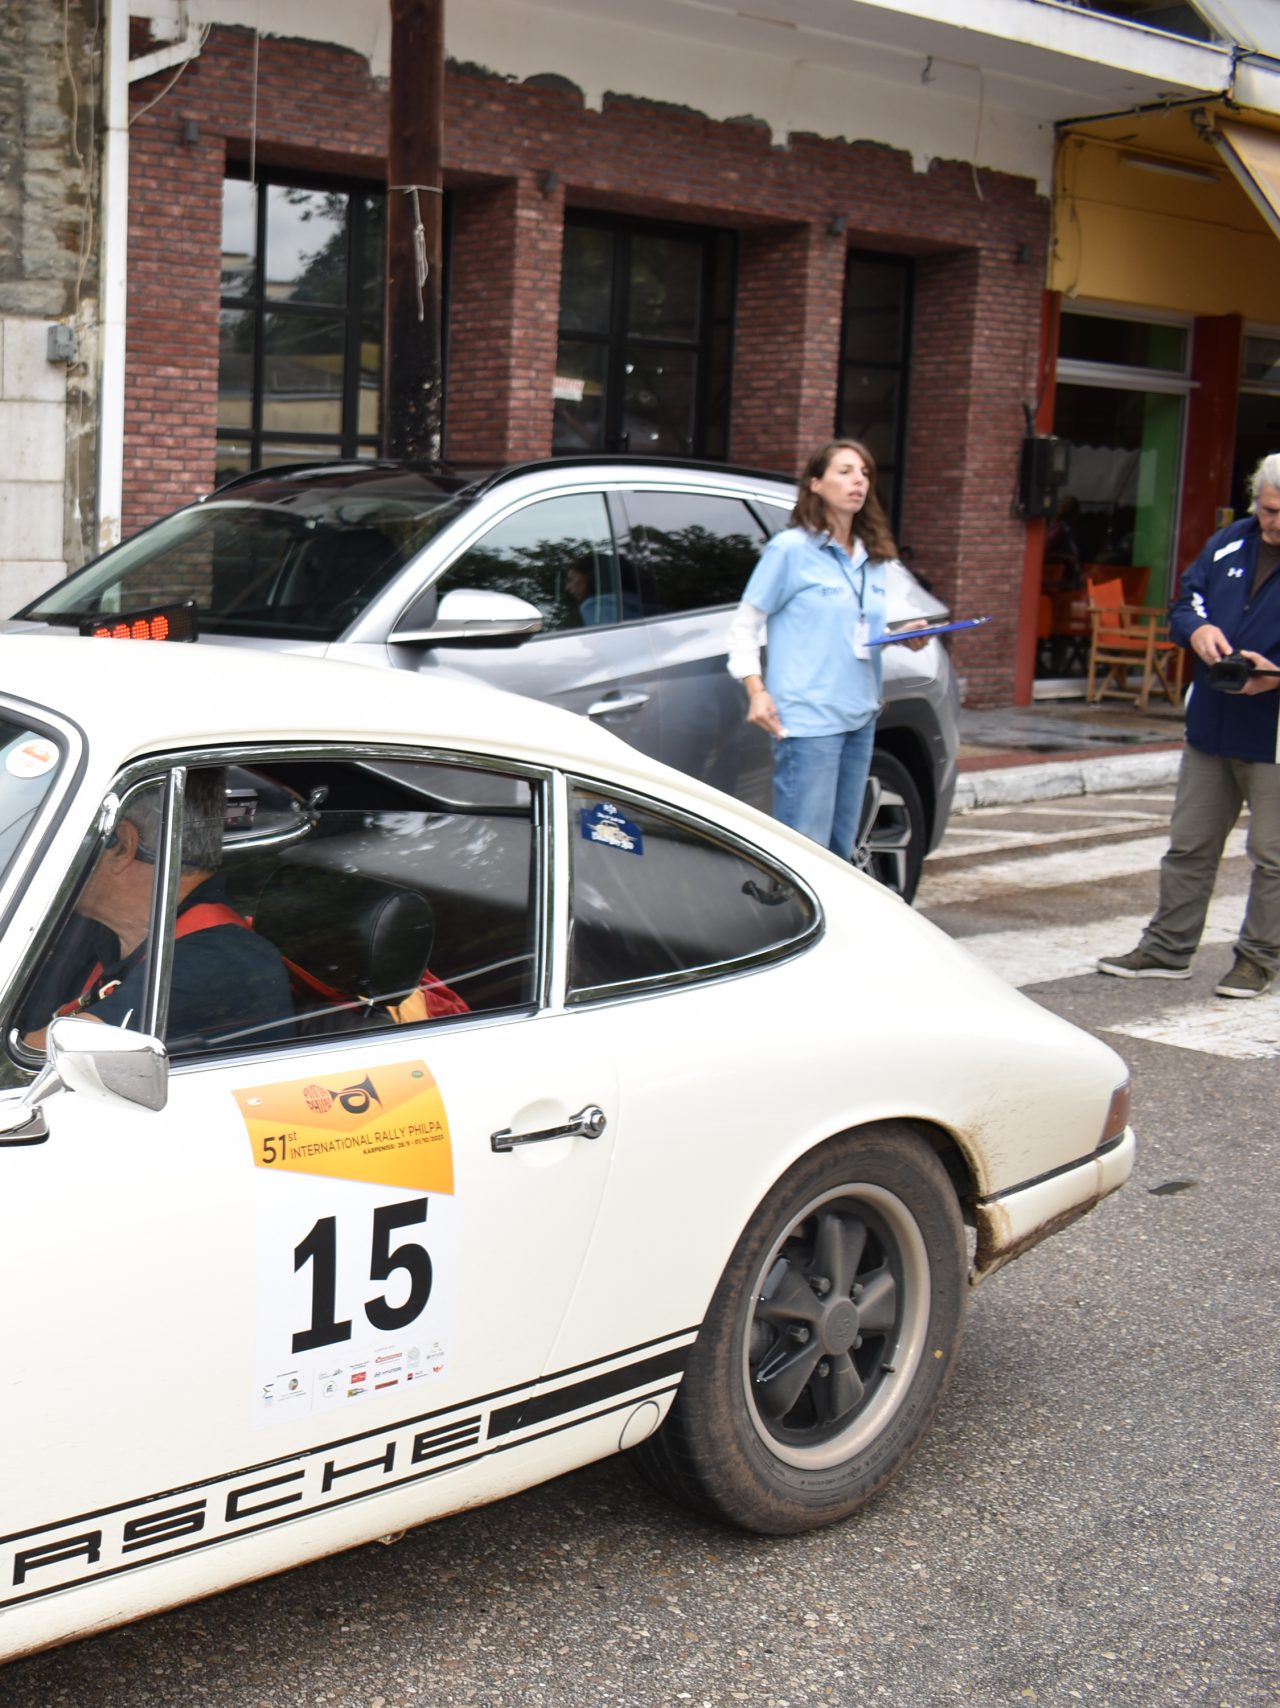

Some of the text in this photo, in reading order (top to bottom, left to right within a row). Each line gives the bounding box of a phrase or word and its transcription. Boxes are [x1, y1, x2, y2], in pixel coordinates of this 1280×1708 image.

[290, 1133, 372, 1160] INTERNATIONAL
[374, 1127, 406, 1144] RALLY
[408, 1121, 443, 1137] PHILPA
[291, 1197, 433, 1354] 15
